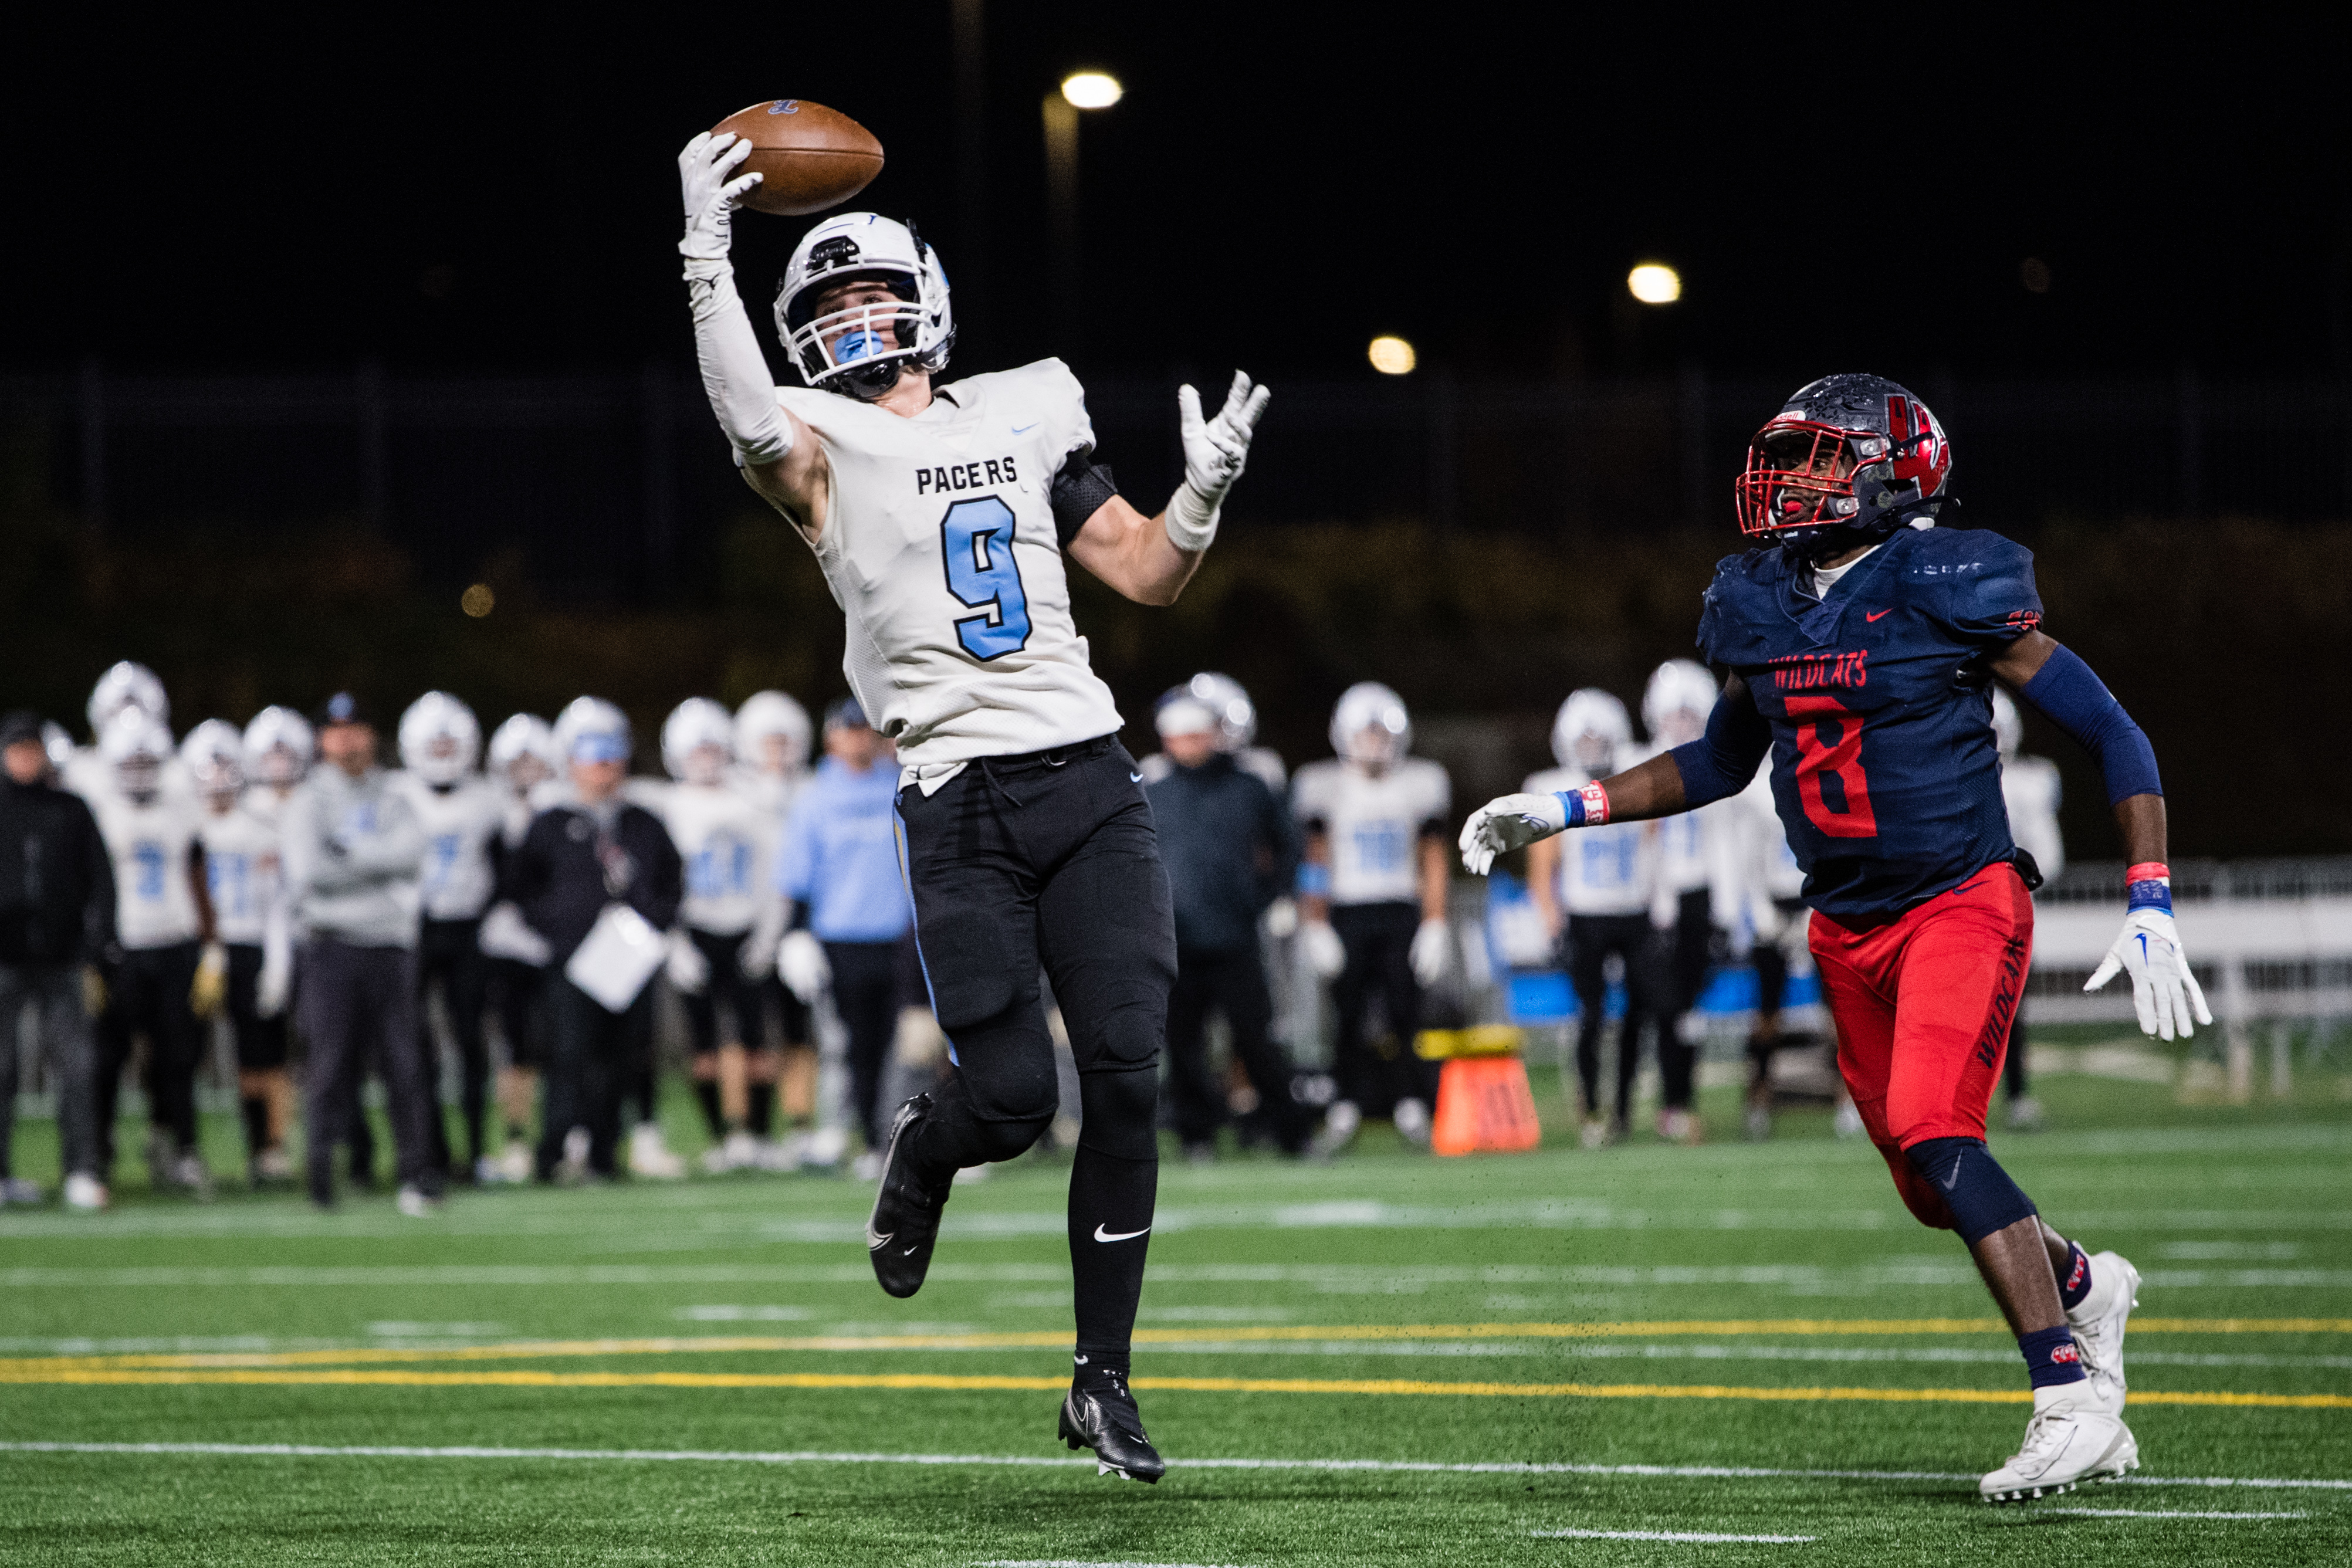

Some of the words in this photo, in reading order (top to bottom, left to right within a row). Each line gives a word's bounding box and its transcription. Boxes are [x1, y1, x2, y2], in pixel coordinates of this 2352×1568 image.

[915, 456, 1017, 495] PACERS
[940, 494, 1033, 663] 9
[1768, 649, 1868, 689] WILDCATS
[1784, 696, 1878, 838] 8
